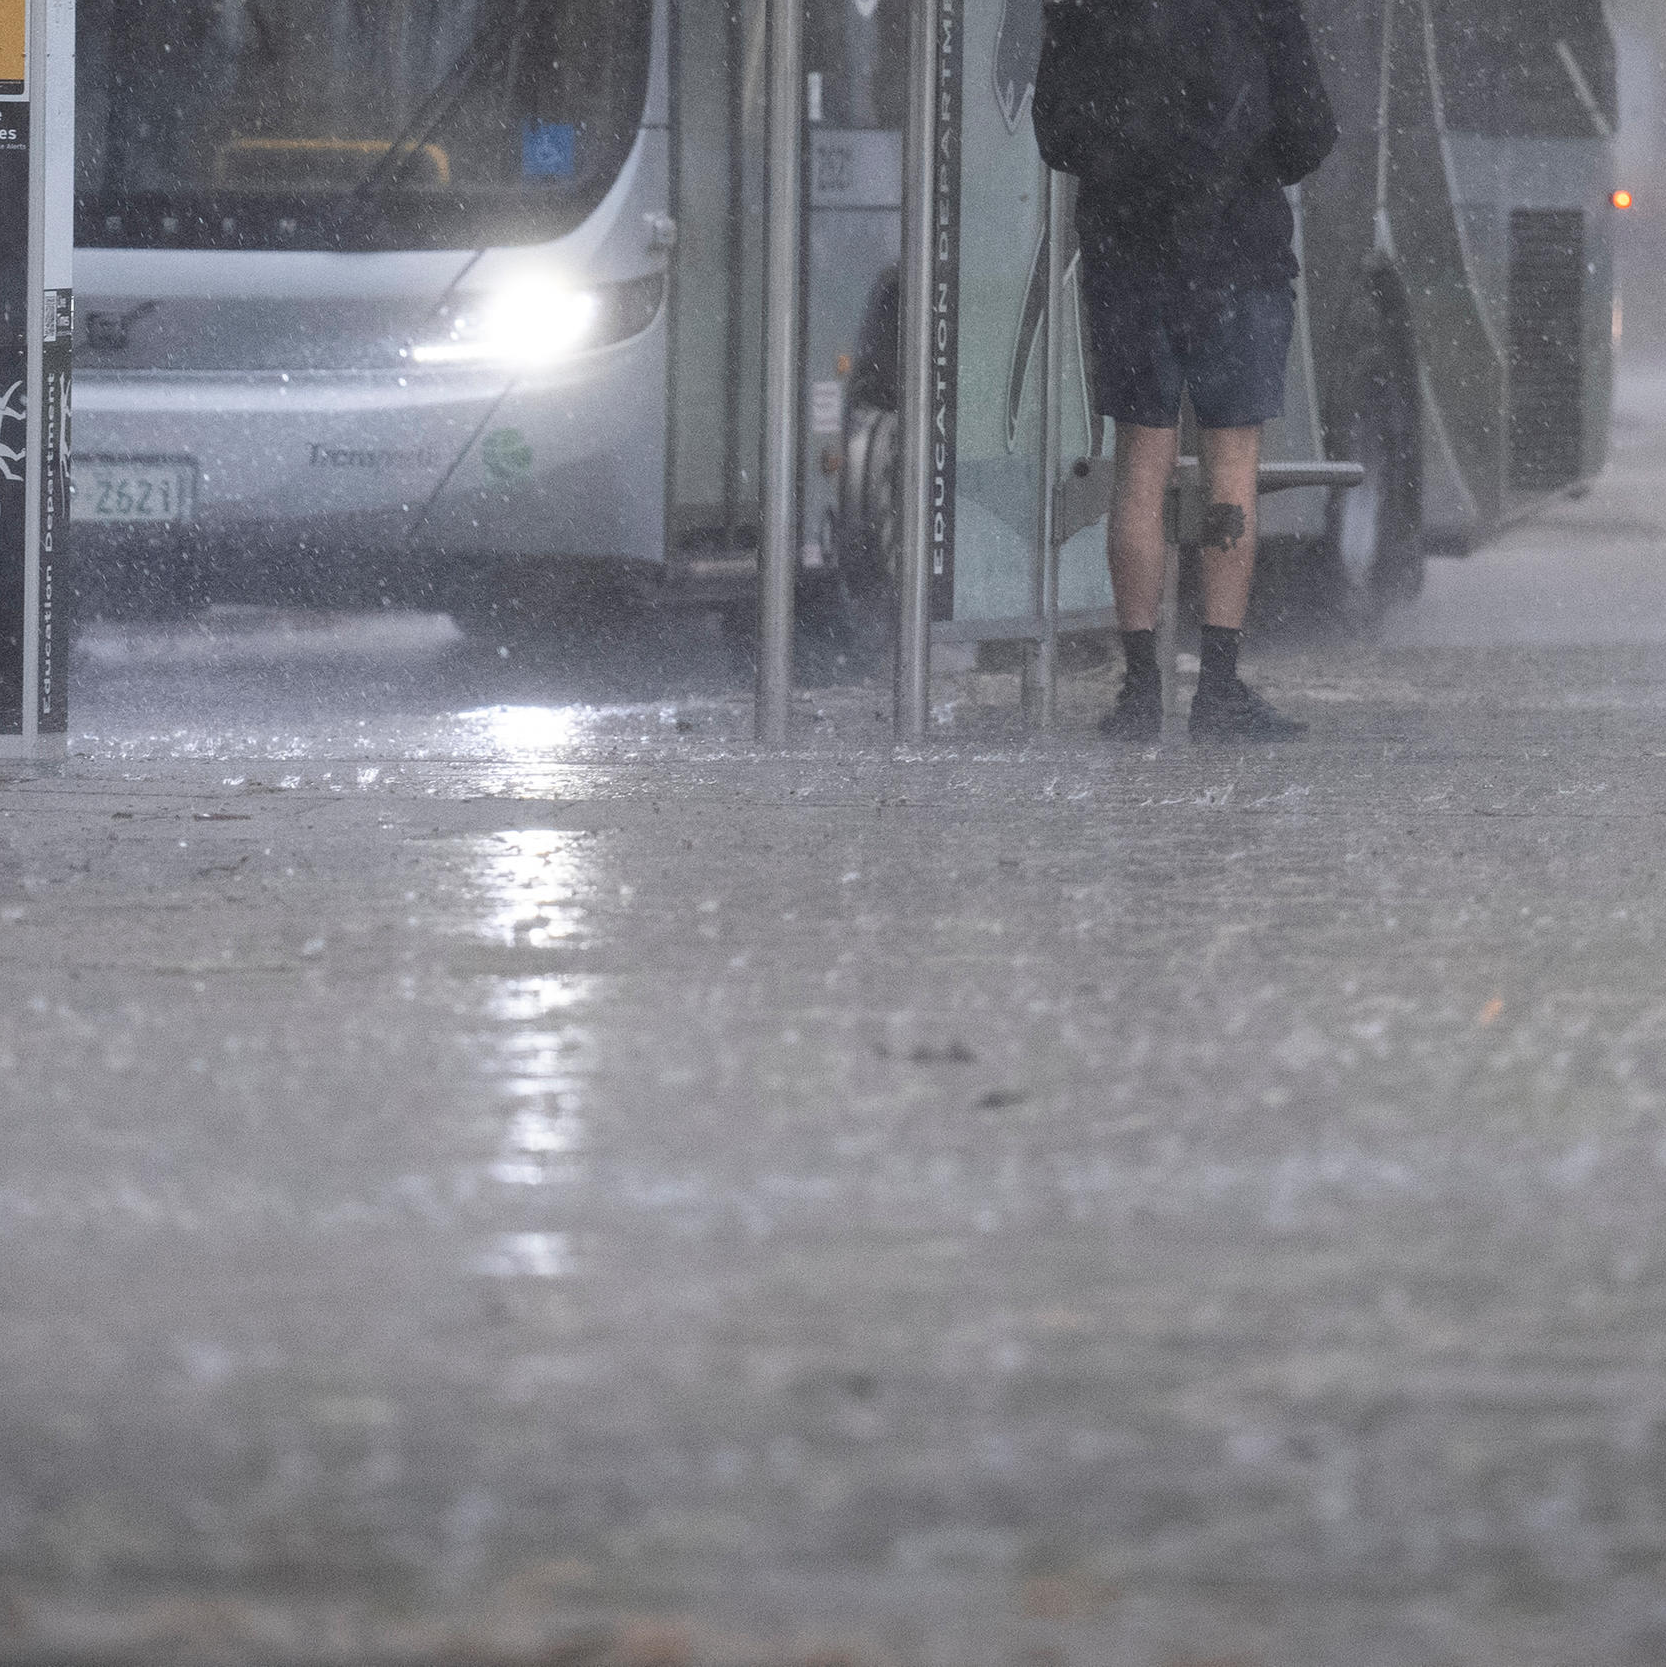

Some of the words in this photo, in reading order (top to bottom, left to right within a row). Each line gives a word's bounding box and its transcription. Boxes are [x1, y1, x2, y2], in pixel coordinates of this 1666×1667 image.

[45, 373, 55, 552] Department
[933, 282, 948, 575] EDUCATION
[43, 565, 52, 714] Education
